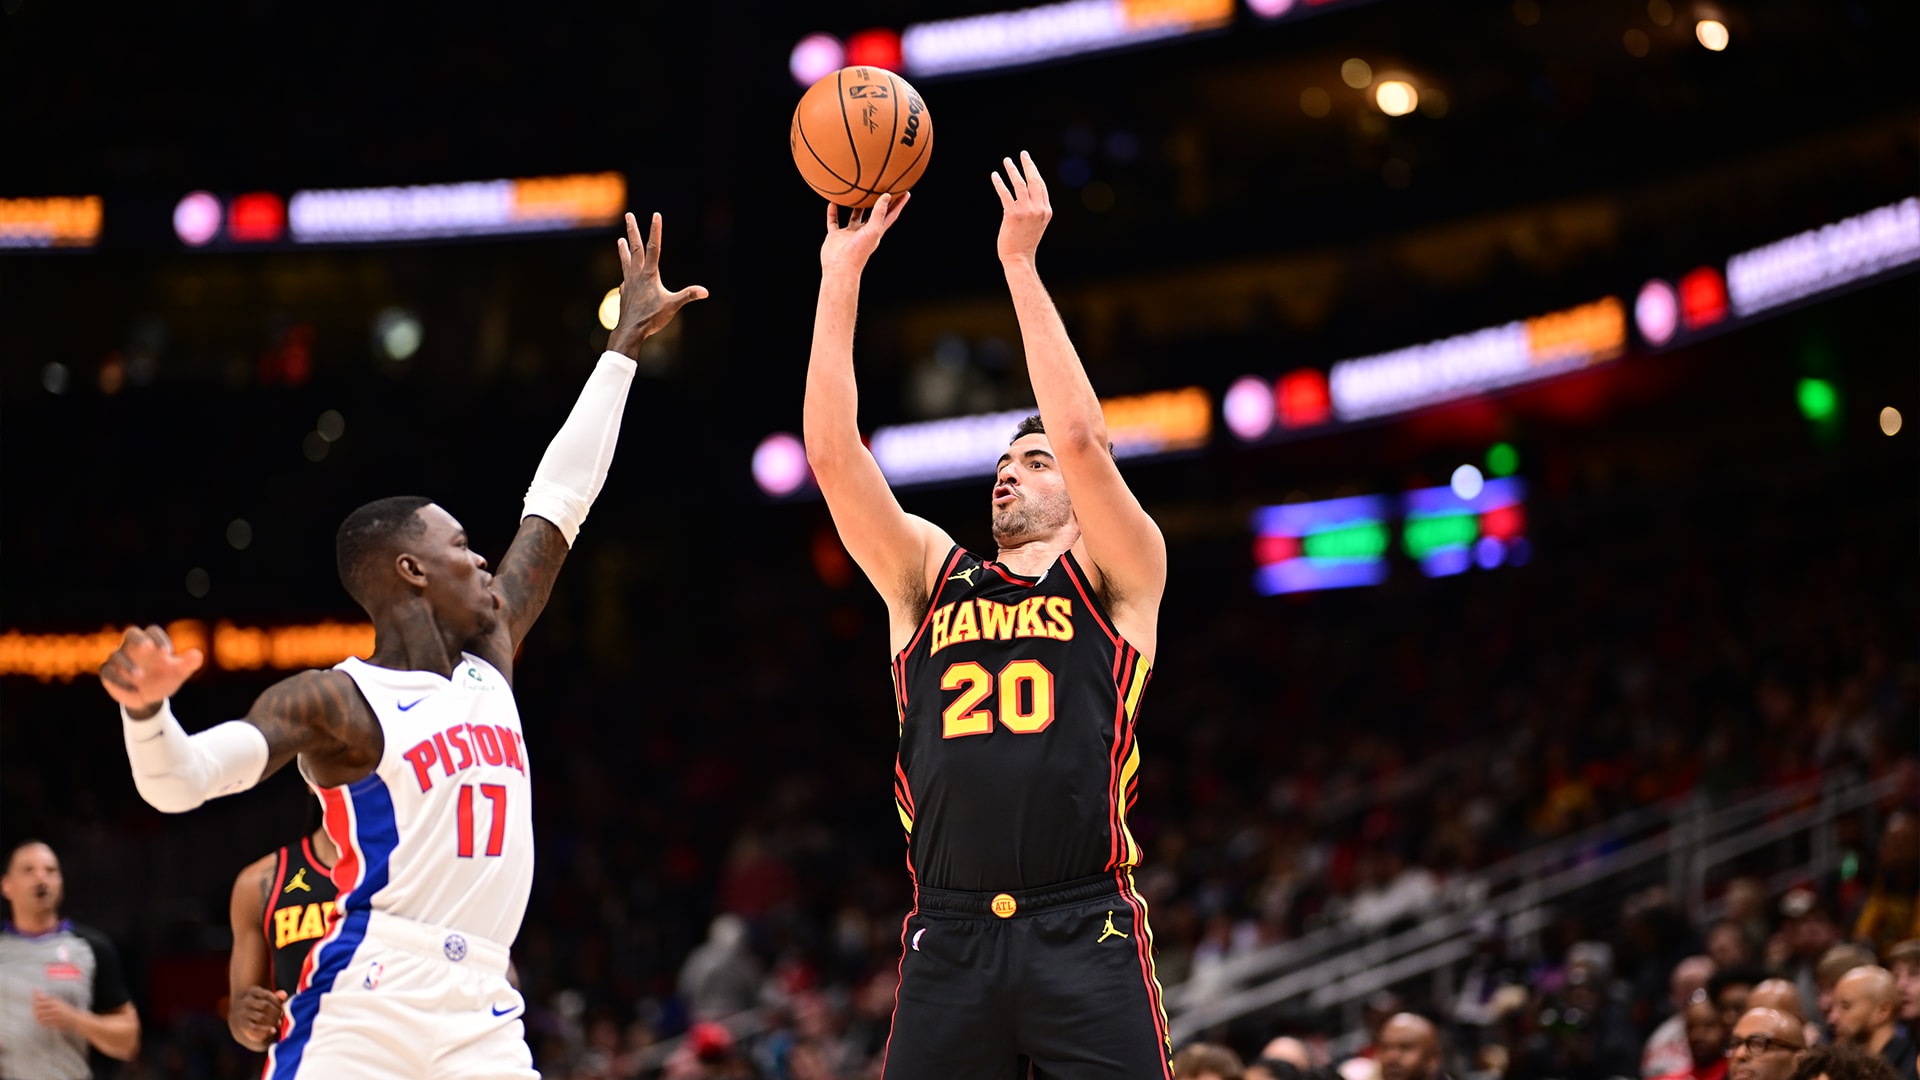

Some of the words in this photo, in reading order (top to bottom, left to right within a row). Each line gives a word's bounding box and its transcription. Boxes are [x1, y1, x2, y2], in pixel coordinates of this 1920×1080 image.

[901, 80, 924, 147] lson
[930, 596, 1074, 658] HAWKS
[940, 659, 1055, 739] 20
[457, 783, 507, 858] 17
[995, 901, 1014, 911] ATL
